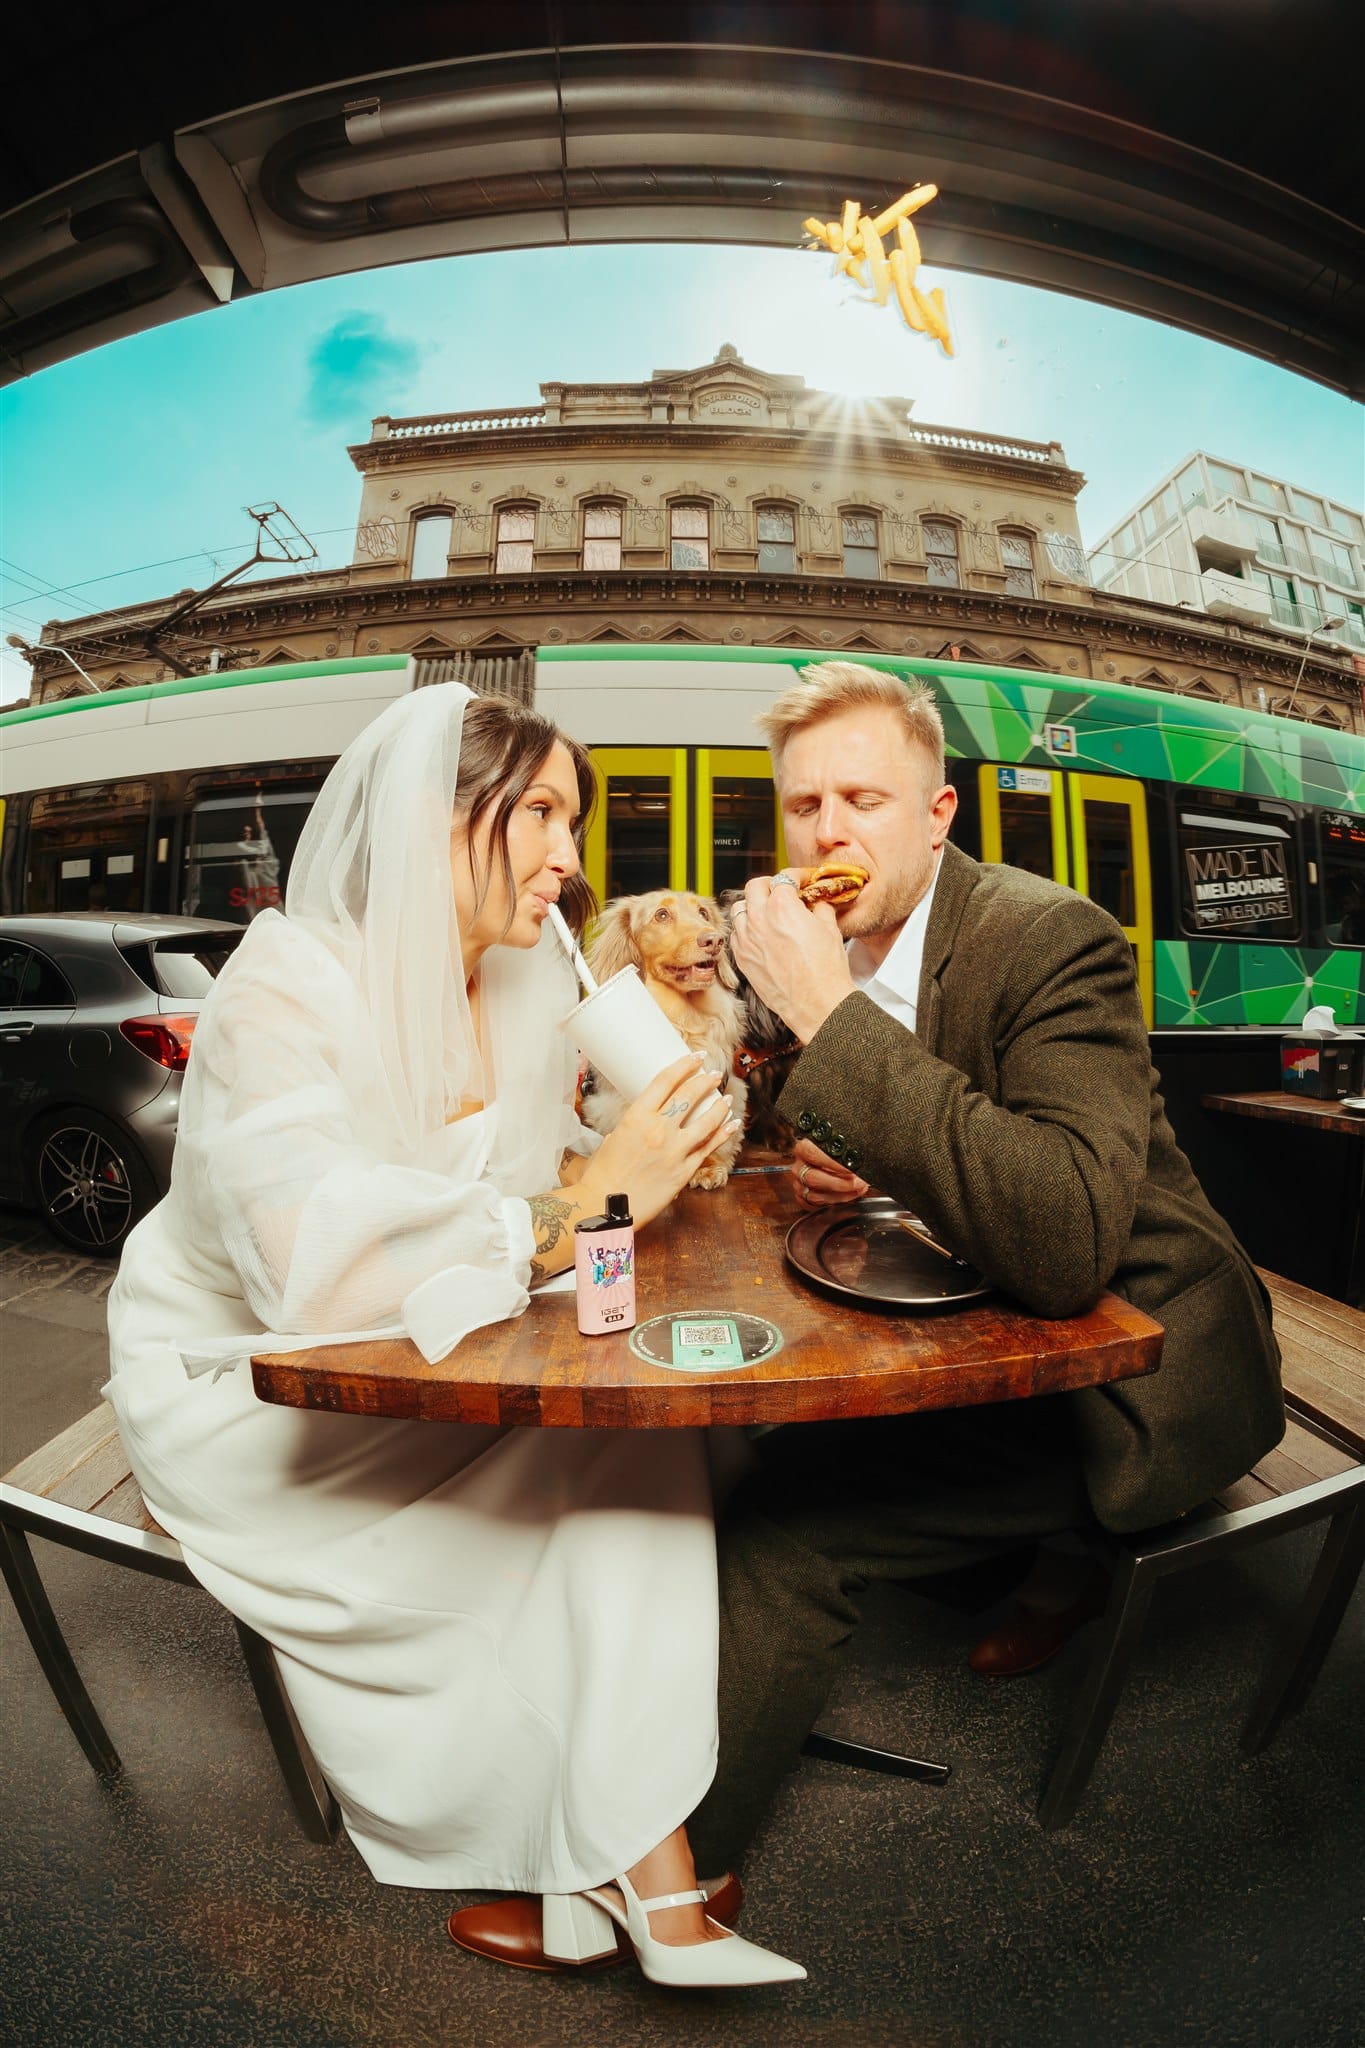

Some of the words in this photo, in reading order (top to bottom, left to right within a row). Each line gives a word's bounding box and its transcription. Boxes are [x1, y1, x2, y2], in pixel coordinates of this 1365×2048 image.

[699, 393, 761, 408] STANFORD
[711, 407, 752, 416] BLOCK
[1190, 849, 1261, 880] MADE
[1196, 877, 1286, 900] MELBOURNE
[601, 1305, 626, 1316] IGET
[607, 1314, 623, 1322] BAR
